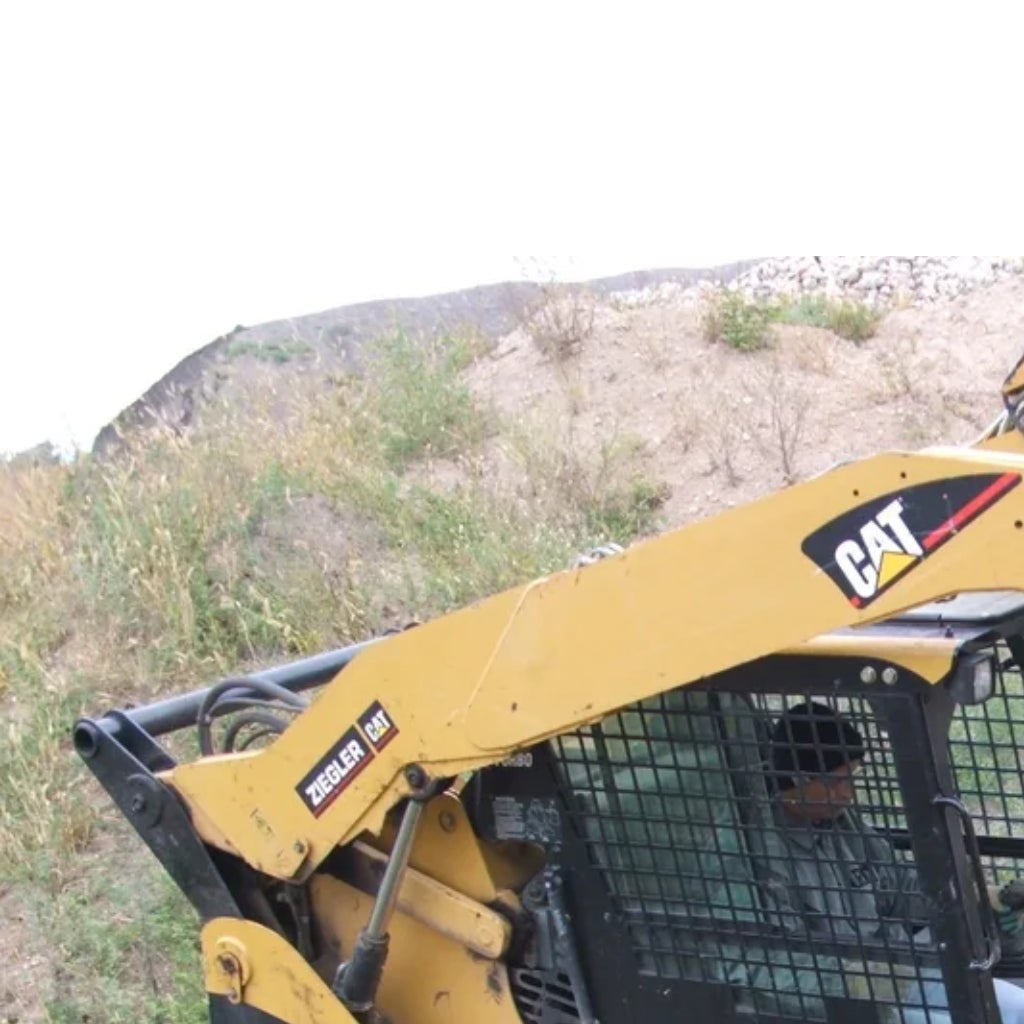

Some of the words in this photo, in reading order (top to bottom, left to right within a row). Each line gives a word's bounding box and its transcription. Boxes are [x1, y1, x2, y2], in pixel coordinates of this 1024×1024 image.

[834, 498, 924, 598] CAT
[305, 739, 365, 806] ZIEGLER
[364, 709, 391, 742] CAT
